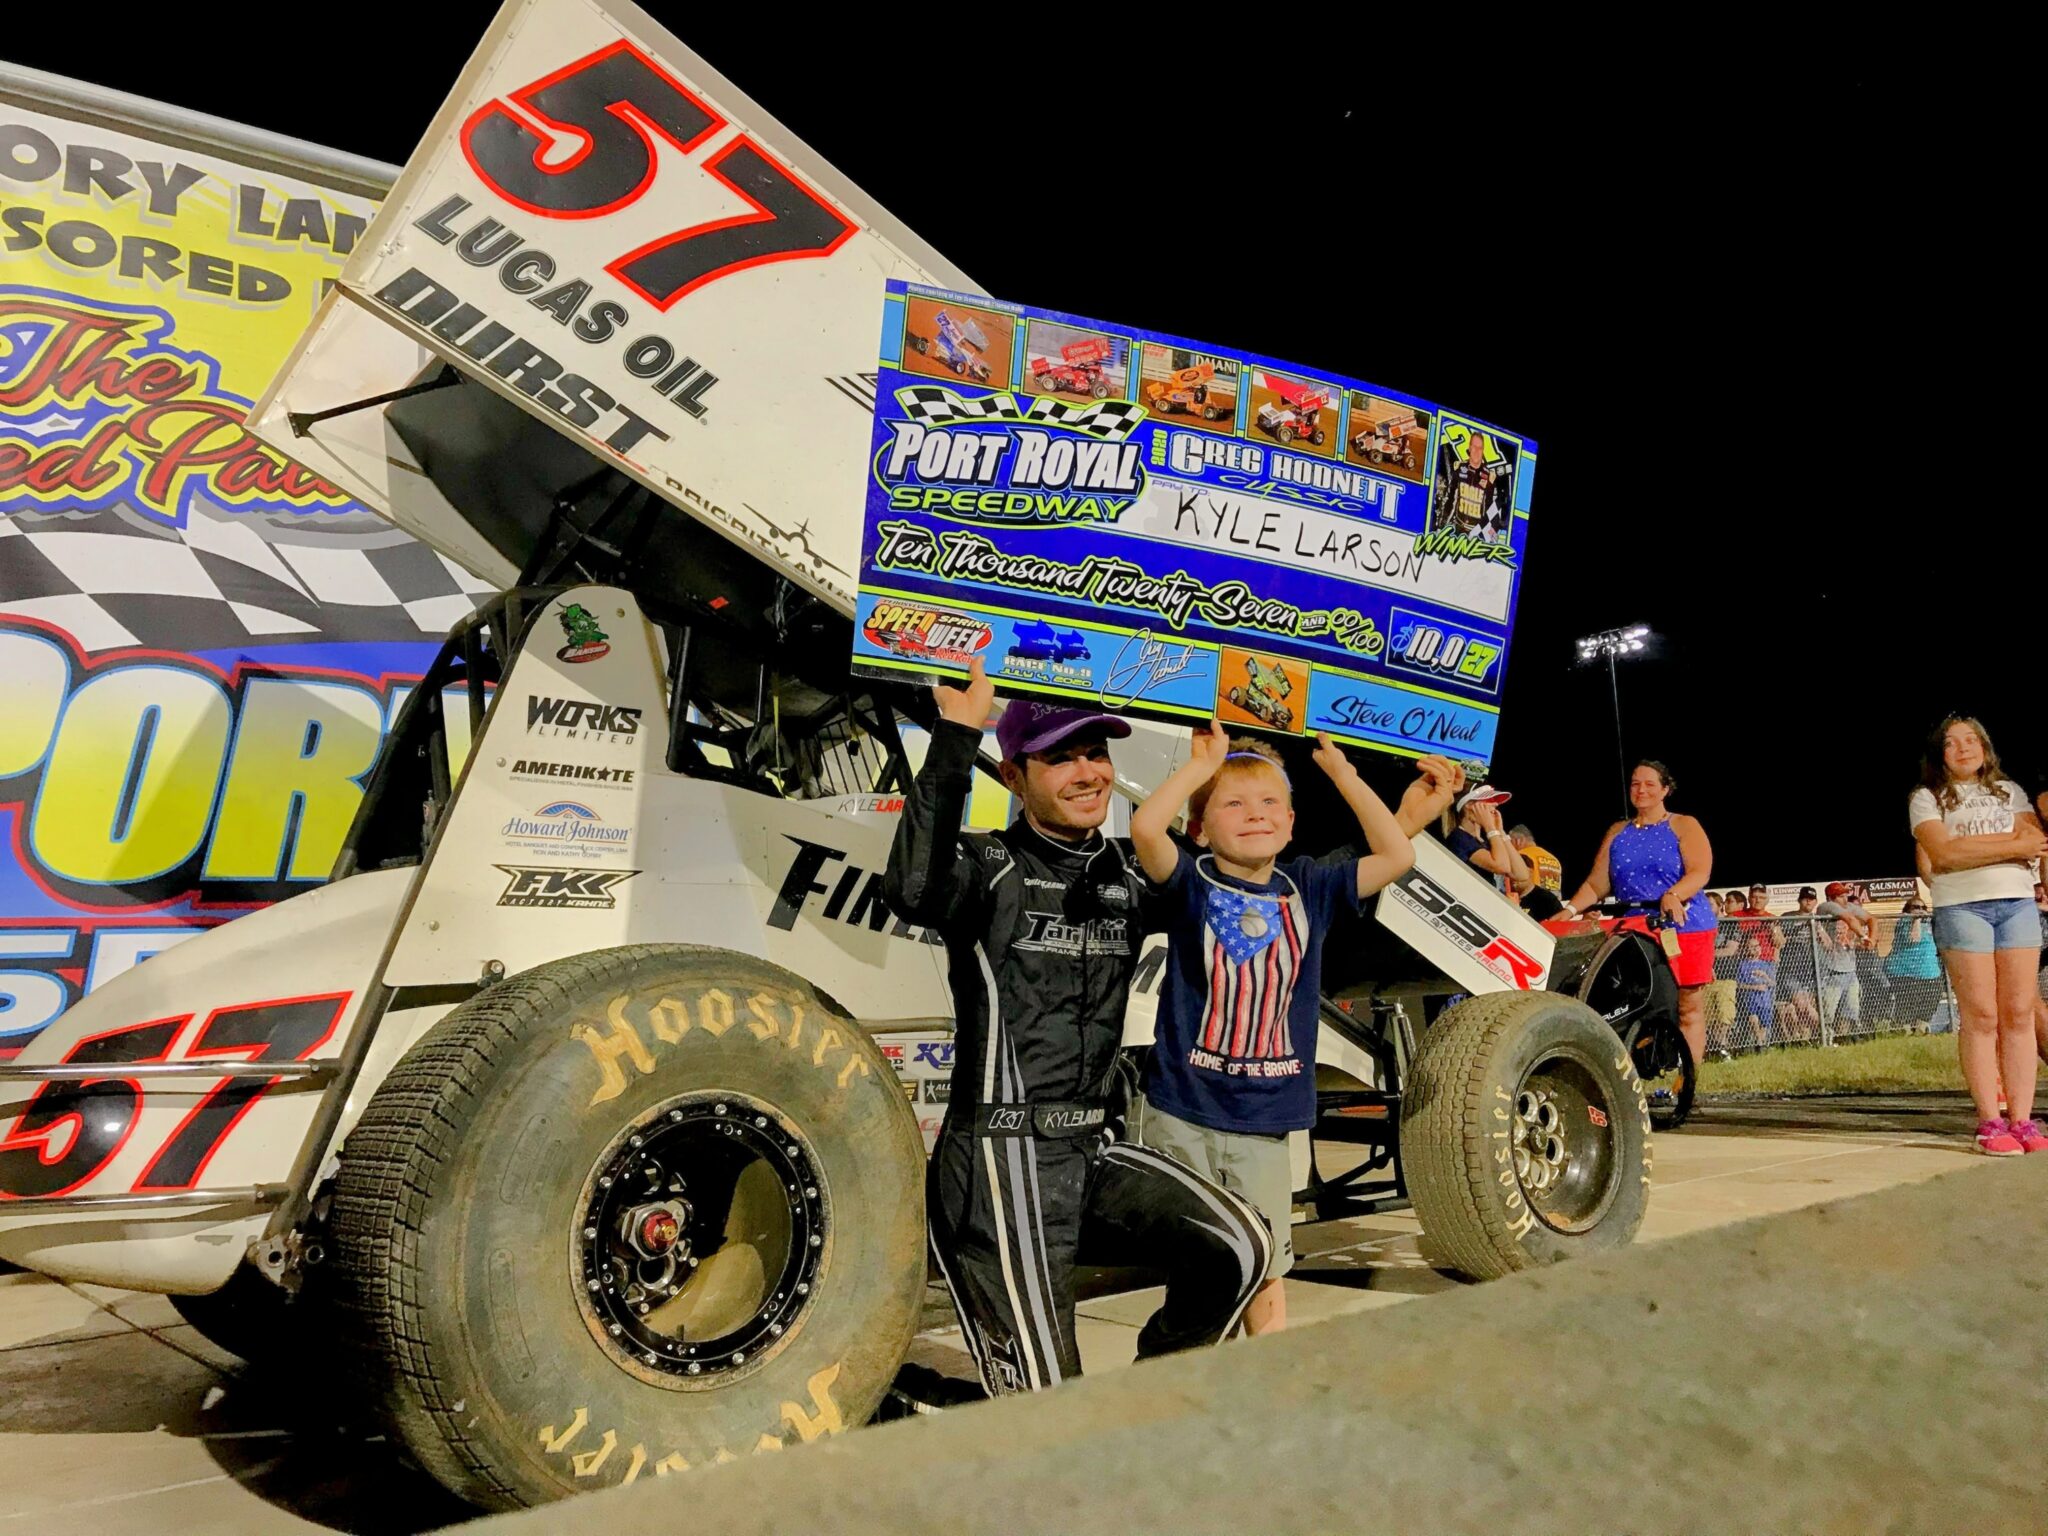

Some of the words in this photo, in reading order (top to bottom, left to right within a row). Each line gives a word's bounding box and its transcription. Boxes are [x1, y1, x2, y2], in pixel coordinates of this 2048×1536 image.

[460, 38, 860, 313] 57
[413, 193, 629, 344] LUCAS
[623, 334, 719, 419] OIL
[374, 267, 672, 454] DURST
[884, 419, 1009, 484] PORT
[1007, 427, 1141, 491] ROYAL
[1172, 433, 1262, 474] GREG
[1271, 452, 1404, 522] HODNETT
[888, 487, 1130, 520] SPEEDWAY
[1174, 491, 1281, 552] KYLE
[1294, 522, 1426, 584] LARSON
[1413, 526, 1518, 570] WINNER
[880, 524, 934, 566] Ten
[941, 535, 1090, 591] Thousand
[1301, 615, 1326, 629] AND
[867, 604, 937, 635] SPEED
[938, 615, 994, 630] SPRINT
[925, 623, 986, 655] WEEK
[1053, 676, 1094, 688] 2020
[527, 695, 642, 734] WORKS
[1330, 696, 1395, 727] Steve
[538, 728, 635, 745] LIMITED
[502, 817, 567, 837] Howard
[566, 820, 630, 842] Johnson
[1869, 881, 1914, 890] SAUSMAN
[1393, 888, 1431, 918] GLENN
[1474, 950, 1513, 983] RACING
[1190, 1048, 1224, 1072] HOME
[1228, 1063, 1243, 1076] OF
[1246, 1062, 1262, 1076] THE
[1264, 1059, 1301, 1077] BRAVE
[0, 991, 354, 1198] 57
[988, 1108, 1025, 1130] K1
